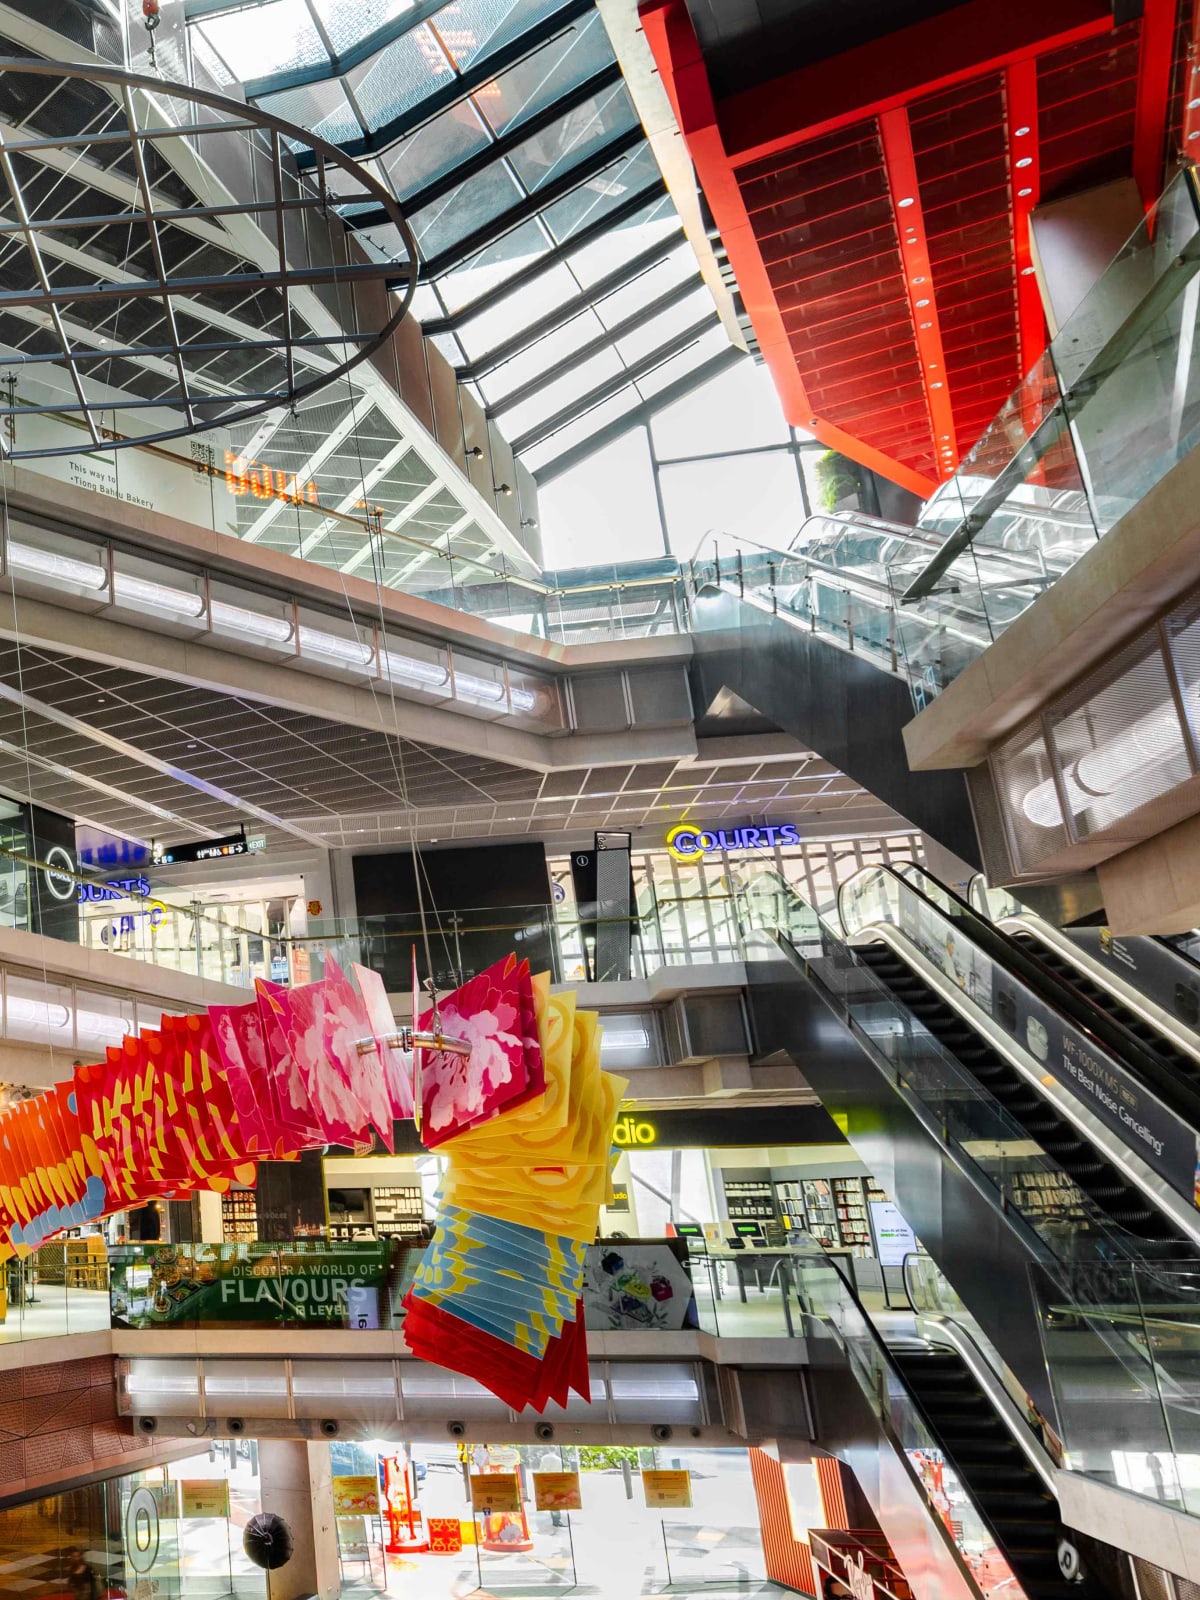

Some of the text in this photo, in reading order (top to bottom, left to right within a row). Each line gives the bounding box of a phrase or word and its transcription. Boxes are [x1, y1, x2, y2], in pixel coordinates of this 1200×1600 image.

[69, 461, 116, 483] This way to
[126, 492, 154, 509] Bakery
[252, 839, 265, 849] EXIT
[670, 823, 800, 856] COURTS
[1062, 1054, 1077, 1077] The
[1077, 1068, 1095, 1094] Best
[1095, 1084, 1118, 1114] Noise
[232, 1264, 376, 1277] DISCOVER A WORLD OF
[220, 1277, 367, 1303] FLAVOURS
[310, 1304, 350, 1316] LEVEL
